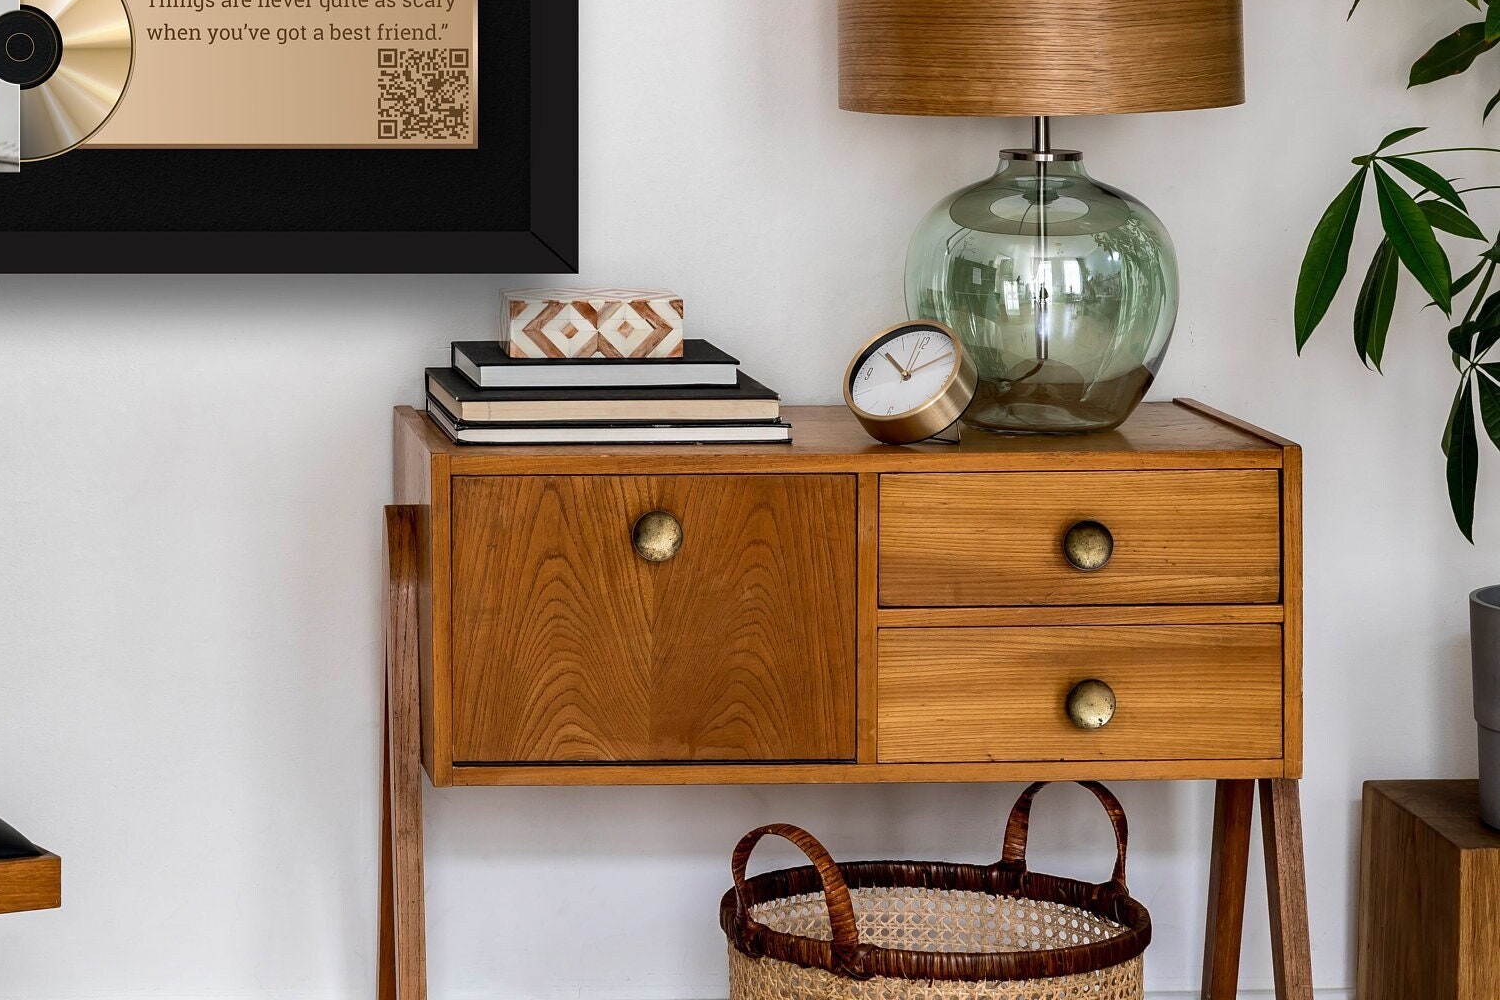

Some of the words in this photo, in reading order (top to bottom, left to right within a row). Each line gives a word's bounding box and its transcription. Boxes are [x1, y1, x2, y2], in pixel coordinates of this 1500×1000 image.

[146, 23, 202, 41] when
[206, 24, 271, 45] you’ve
[276, 26, 307, 45] got
[313, 28, 325, 41] a
[329, 23, 372, 41] best
[918, 336, 931, 350] 12
[864, 367, 874, 381] 9
